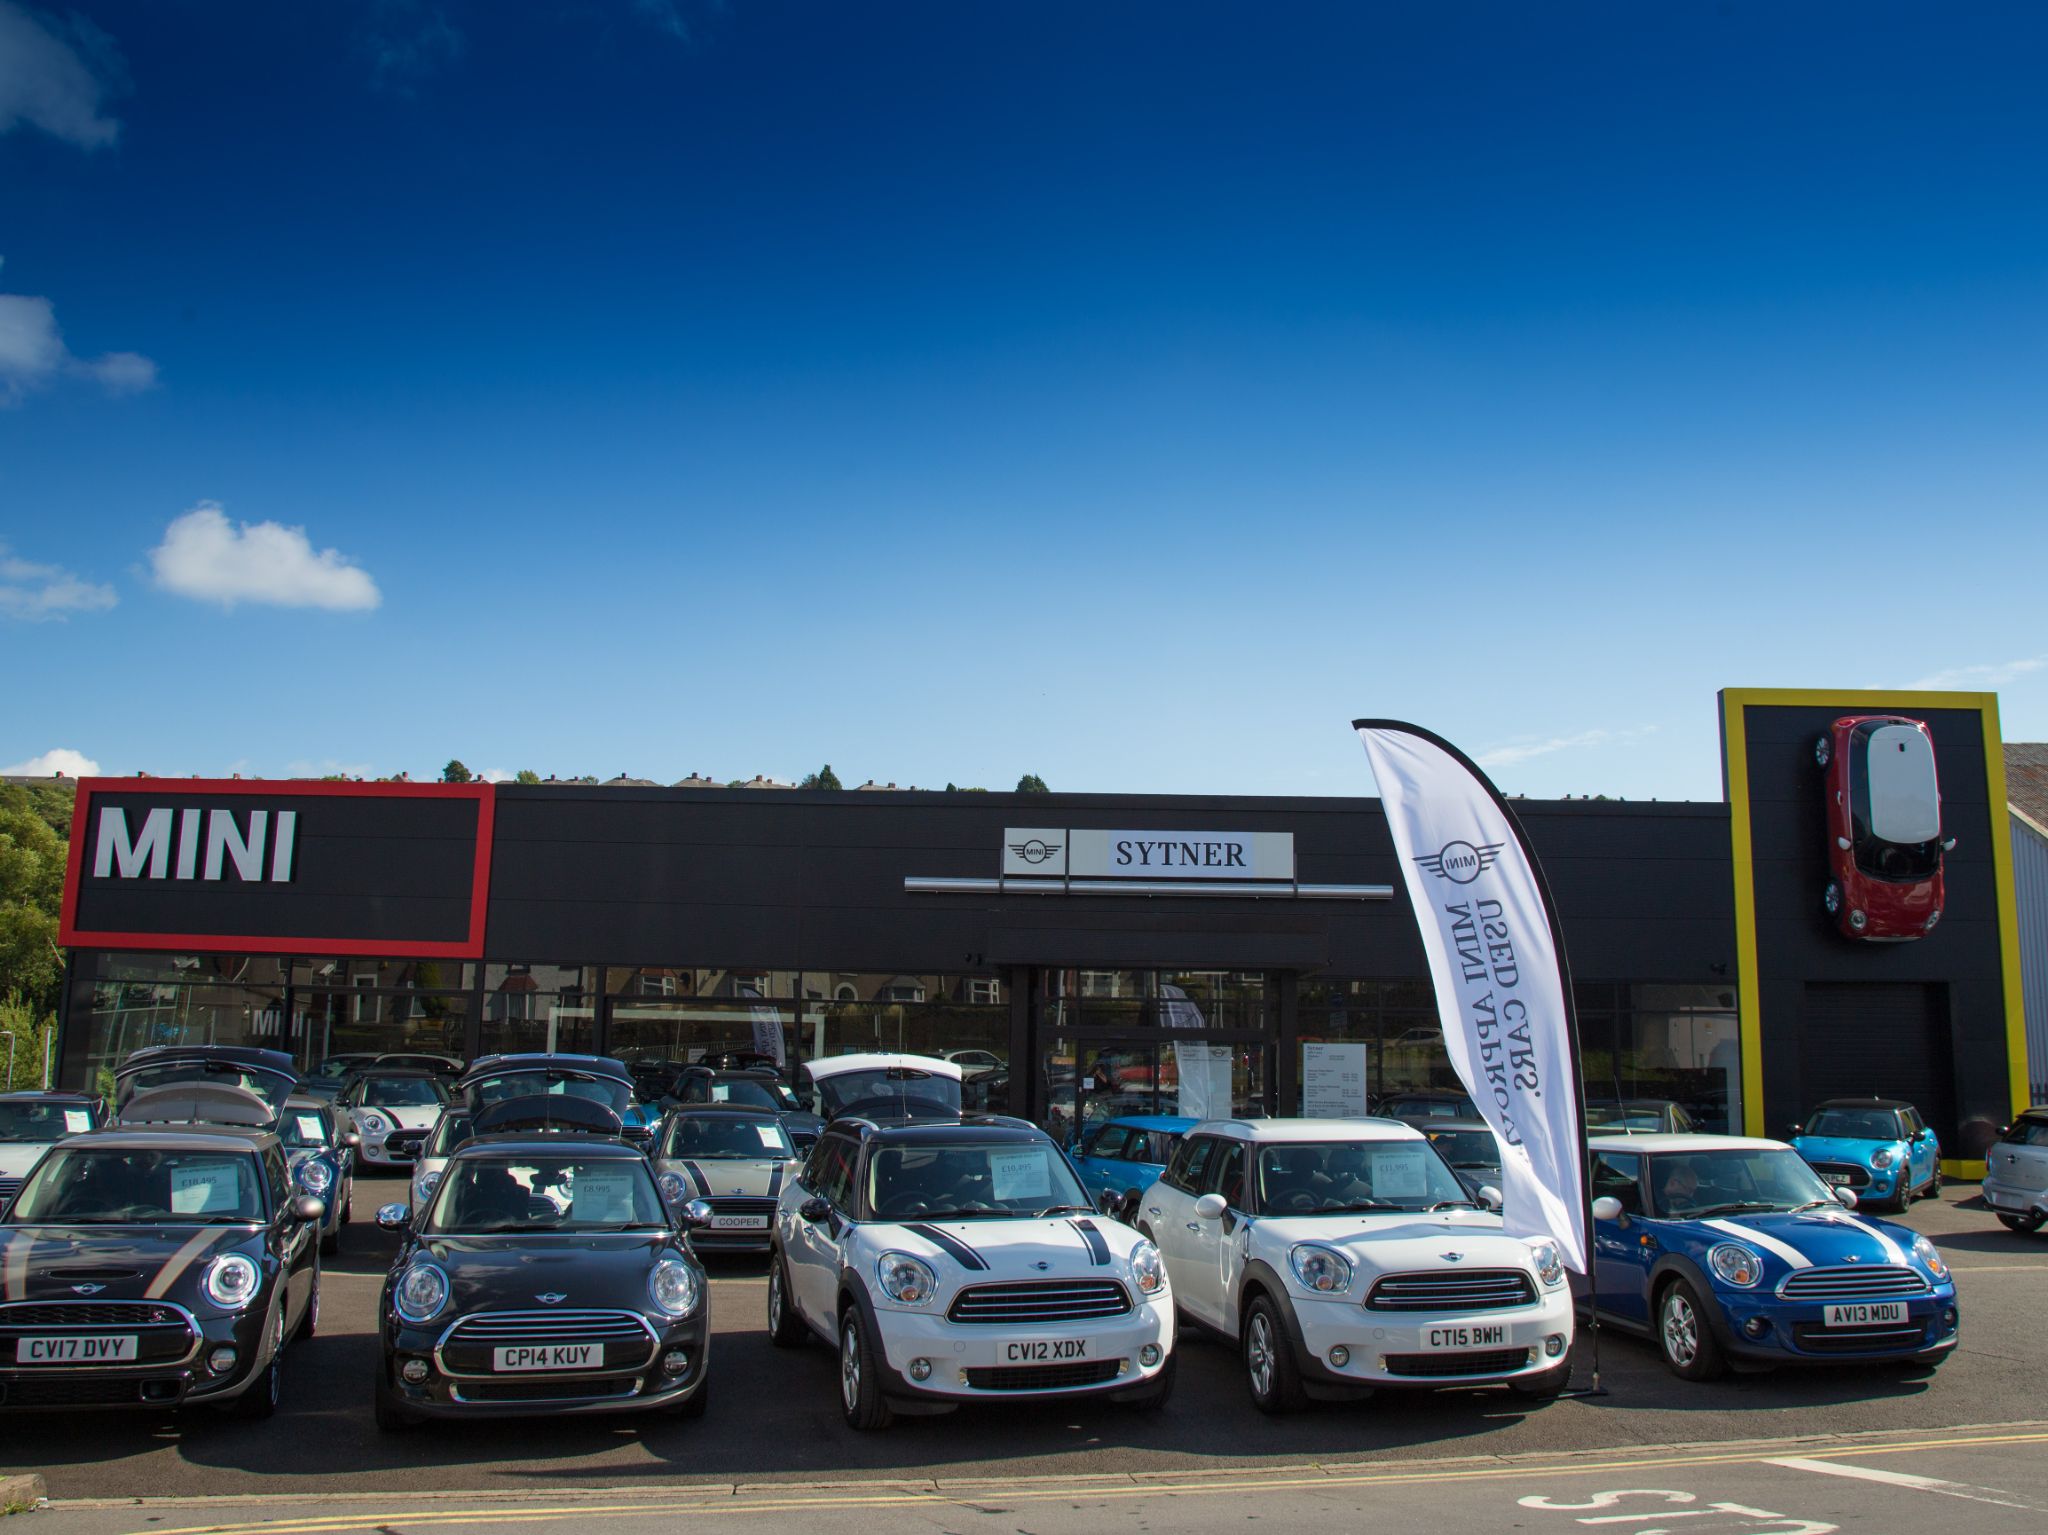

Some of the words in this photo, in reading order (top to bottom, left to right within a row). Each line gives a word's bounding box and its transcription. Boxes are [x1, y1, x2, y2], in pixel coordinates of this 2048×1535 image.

[93, 806, 297, 883] MINI
[1026, 848, 1044, 856] MINI
[1116, 840, 1247, 867] SYTNER
[719, 1217, 760, 1226] COOPER
[1834, 1306, 1867, 1322] AV13
[1870, 1304, 1899, 1321] MDU
[1430, 1328, 1468, 1346] CT15
[1472, 1326, 1503, 1344] BWH
[31, 1340, 78, 1358] CV17
[83, 1338, 126, 1357] DVY
[505, 1348, 547, 1366] CP14
[553, 1346, 591, 1364] KUY
[1008, 1342, 1048, 1360] CV12
[1053, 1339, 1086, 1358] XDX
